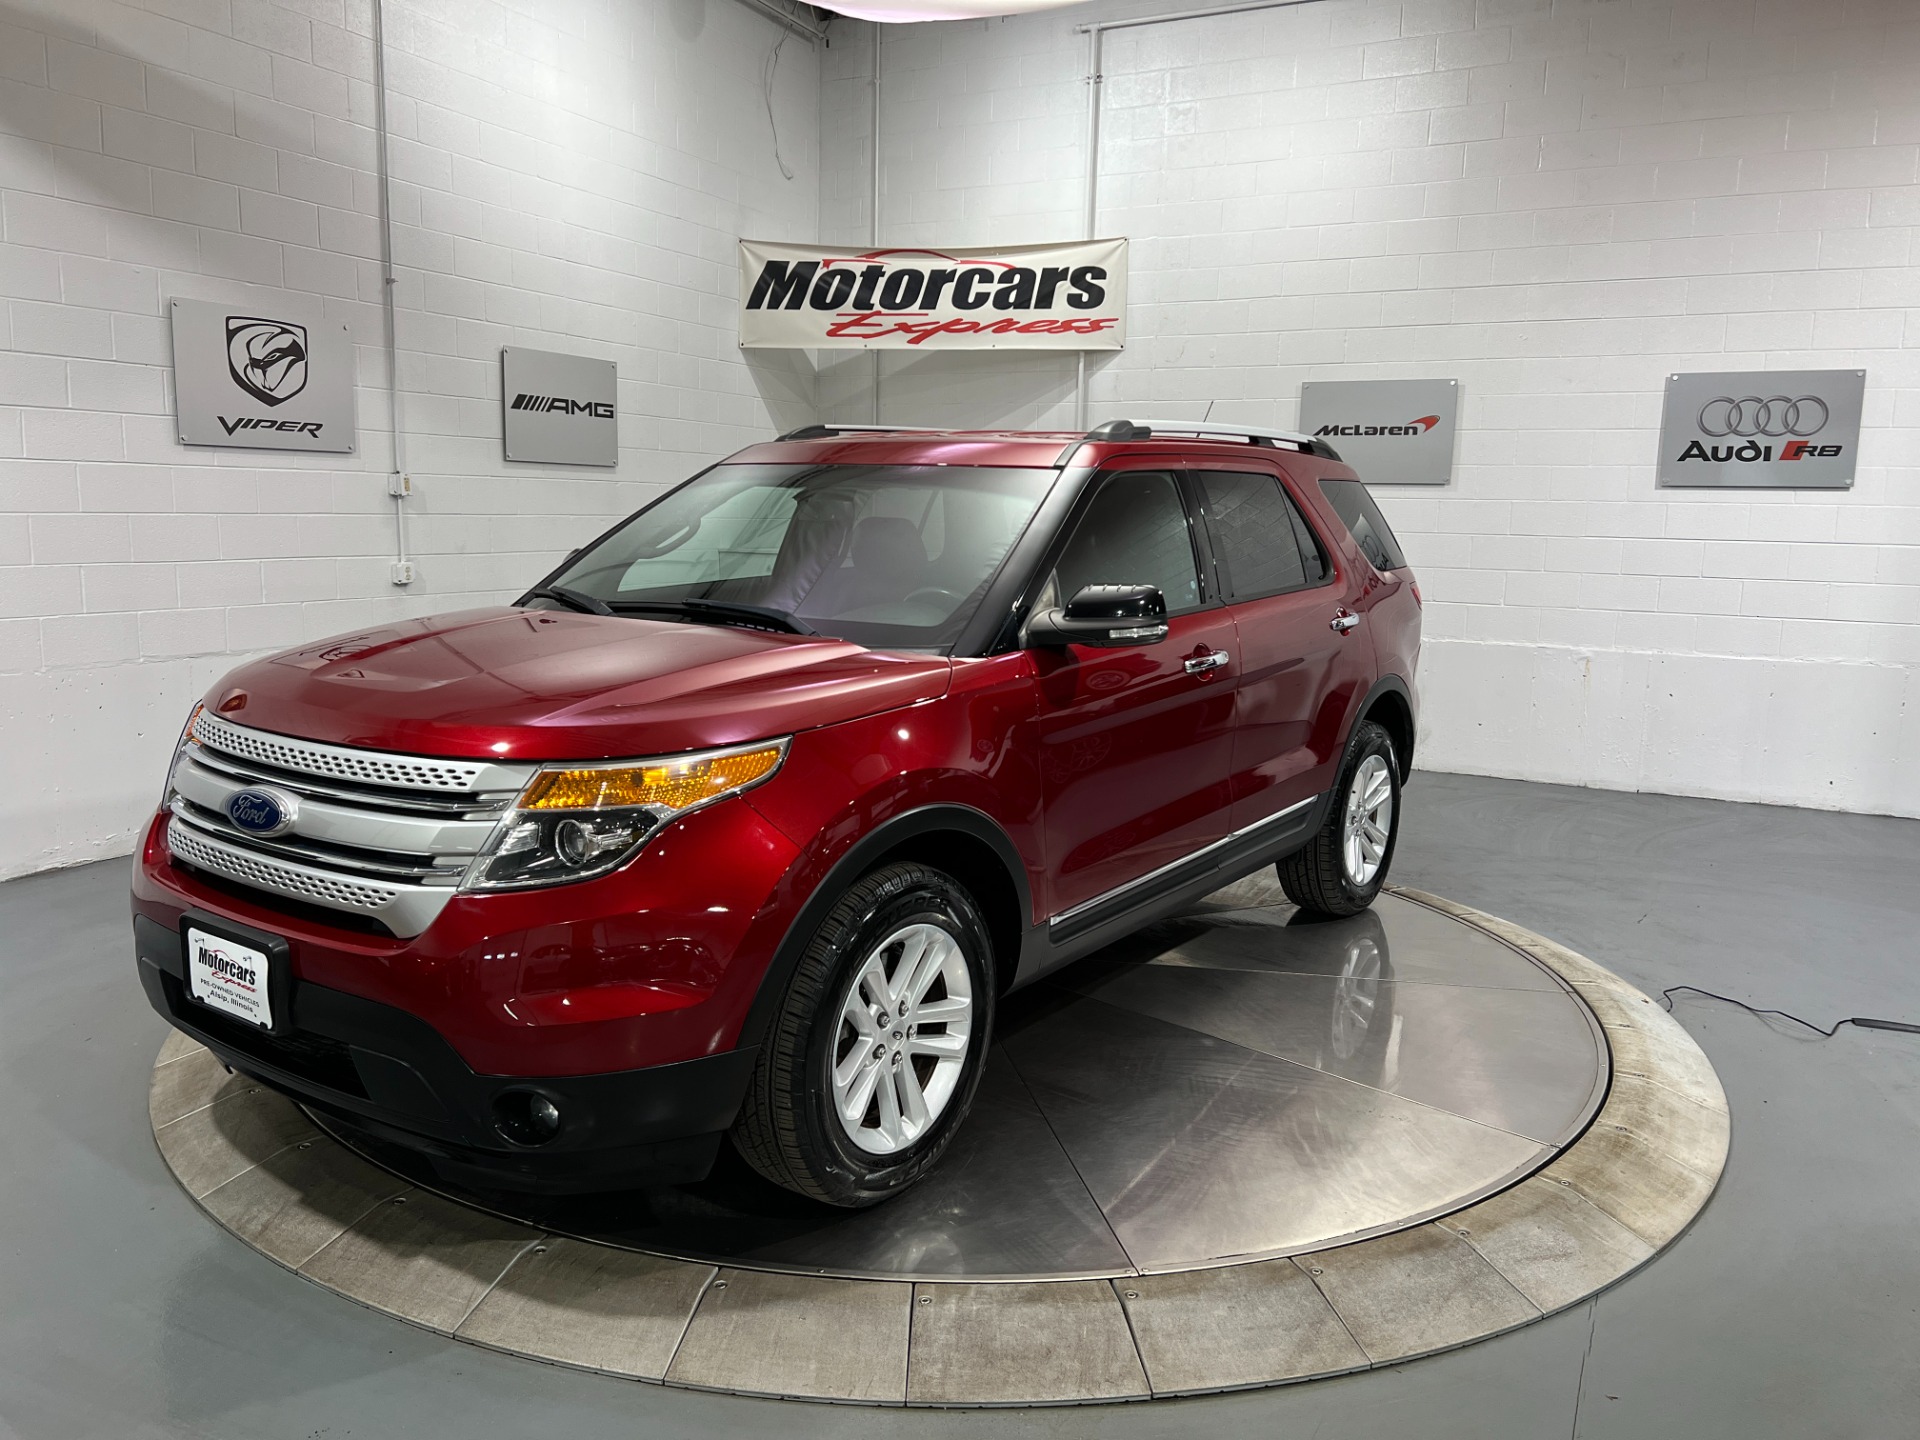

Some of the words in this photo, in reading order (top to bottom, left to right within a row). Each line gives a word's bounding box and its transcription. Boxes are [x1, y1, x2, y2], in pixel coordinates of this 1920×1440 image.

[745, 260, 1107, 311] Motorcars
[826, 311, 1119, 345] Express
[545, 397, 614, 419] AMG
[216, 415, 324, 439] VIPER
[1312, 424, 1419, 437] McLaren
[1676, 440, 1773, 462] Audi
[1791, 445, 1843, 458] R8
[232, 794, 270, 825] Ford
[198, 946, 256, 986] Motorcars
[200, 978, 234, 996] PRE-OWNED
[235, 991, 260, 1008] VEHICLES
[211, 971, 257, 993] Express
[209, 989, 230, 1003] Alsip,
[230, 997, 254, 1013] Illinois
